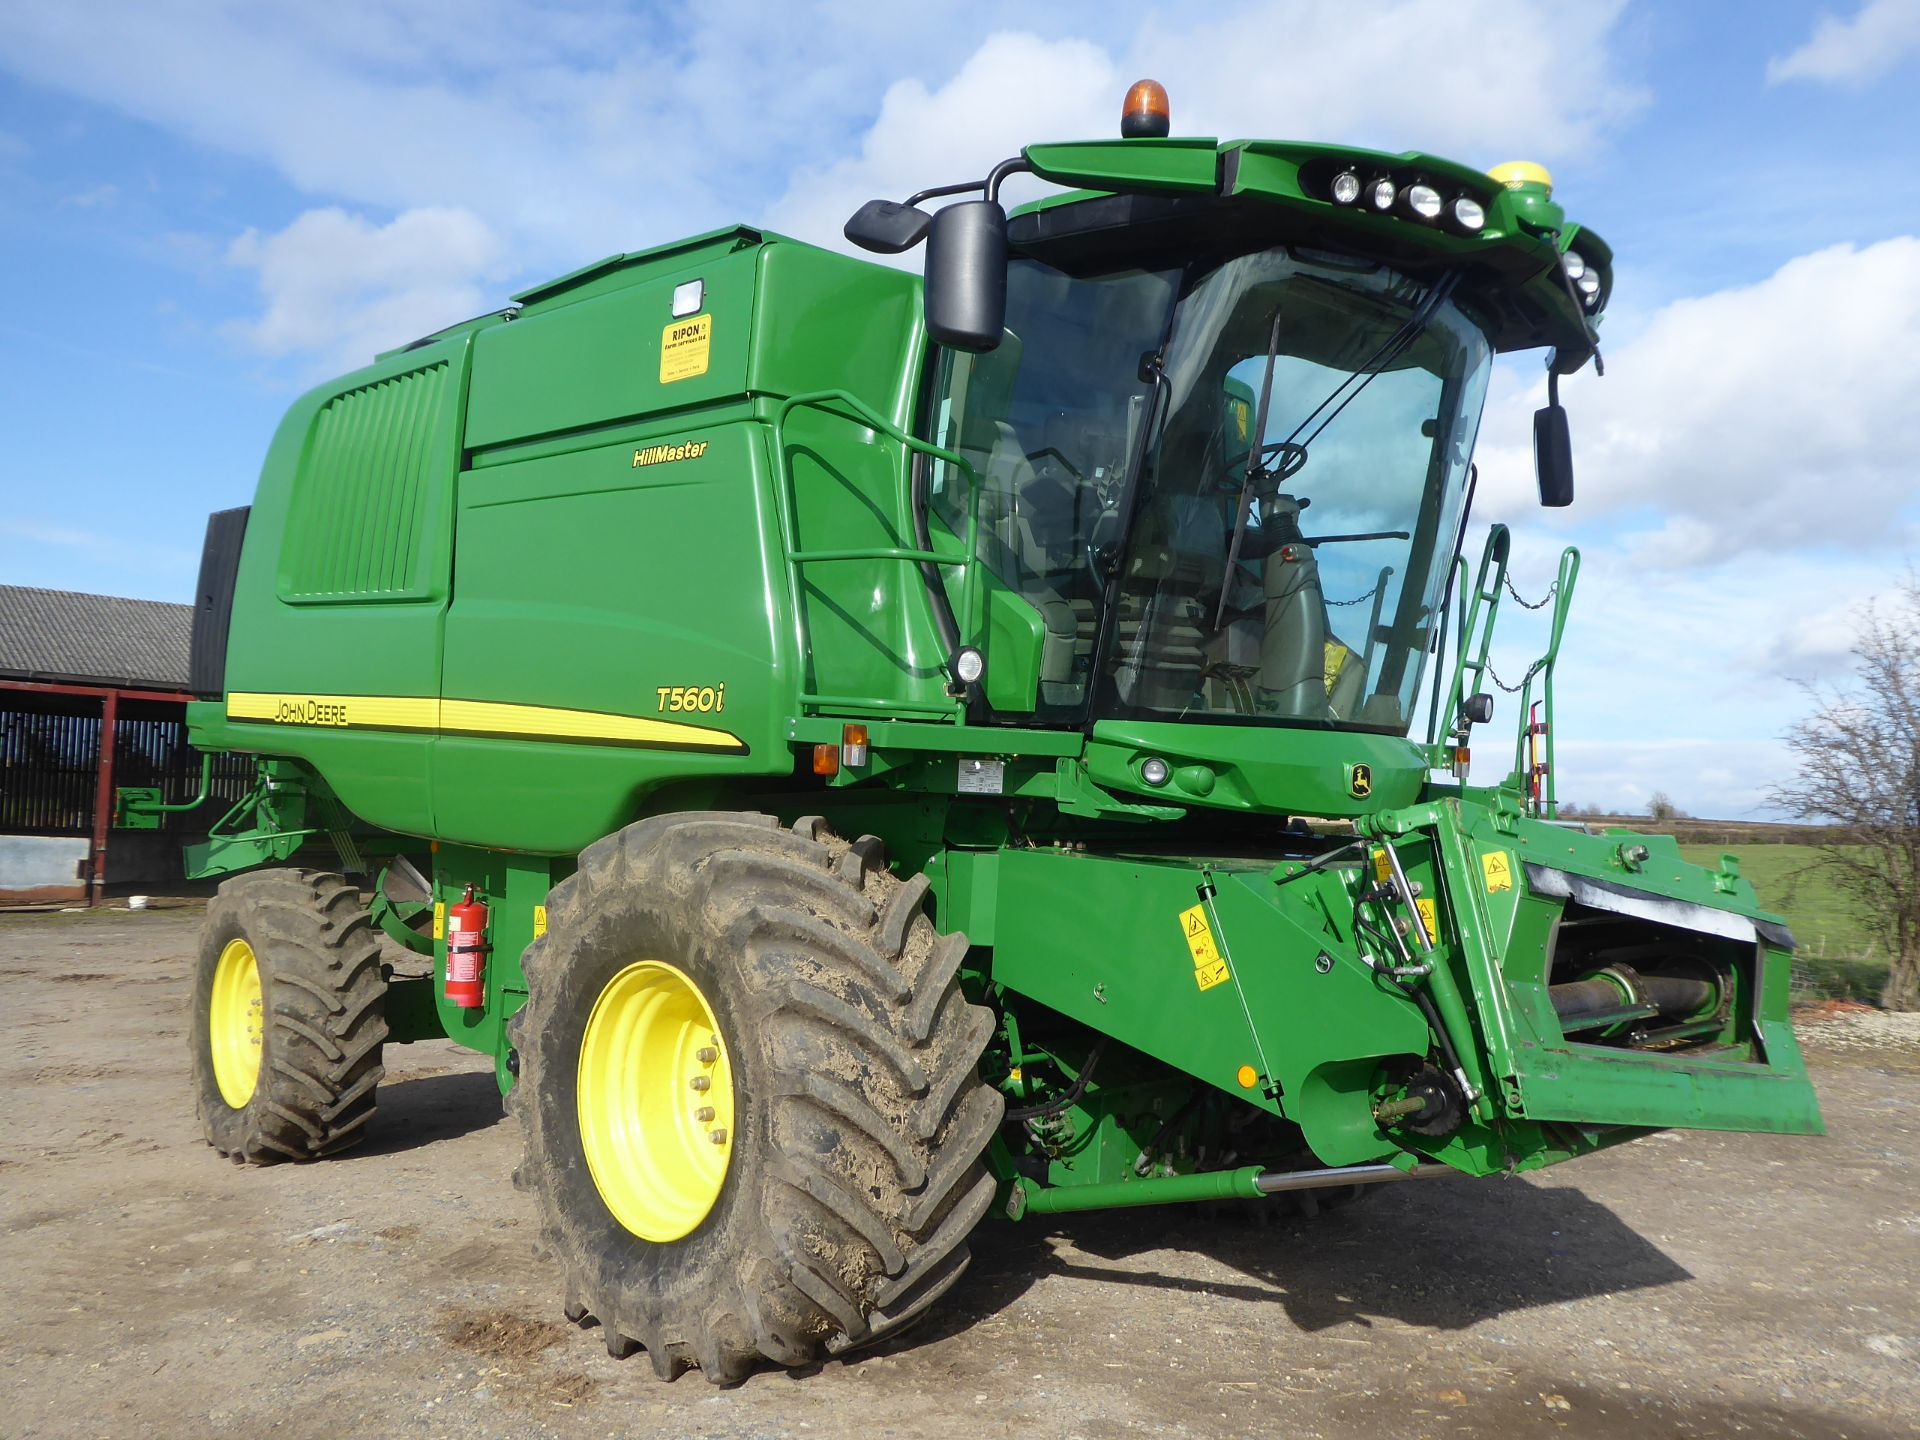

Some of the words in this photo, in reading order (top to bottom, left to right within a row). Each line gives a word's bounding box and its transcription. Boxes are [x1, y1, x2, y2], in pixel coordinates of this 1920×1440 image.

[672, 324, 700, 341] RIPON
[632, 441, 708, 467] HillMaster
[657, 682, 725, 713] T560i
[275, 699, 305, 721] JOHN
[307, 701, 347, 724] DEERE
